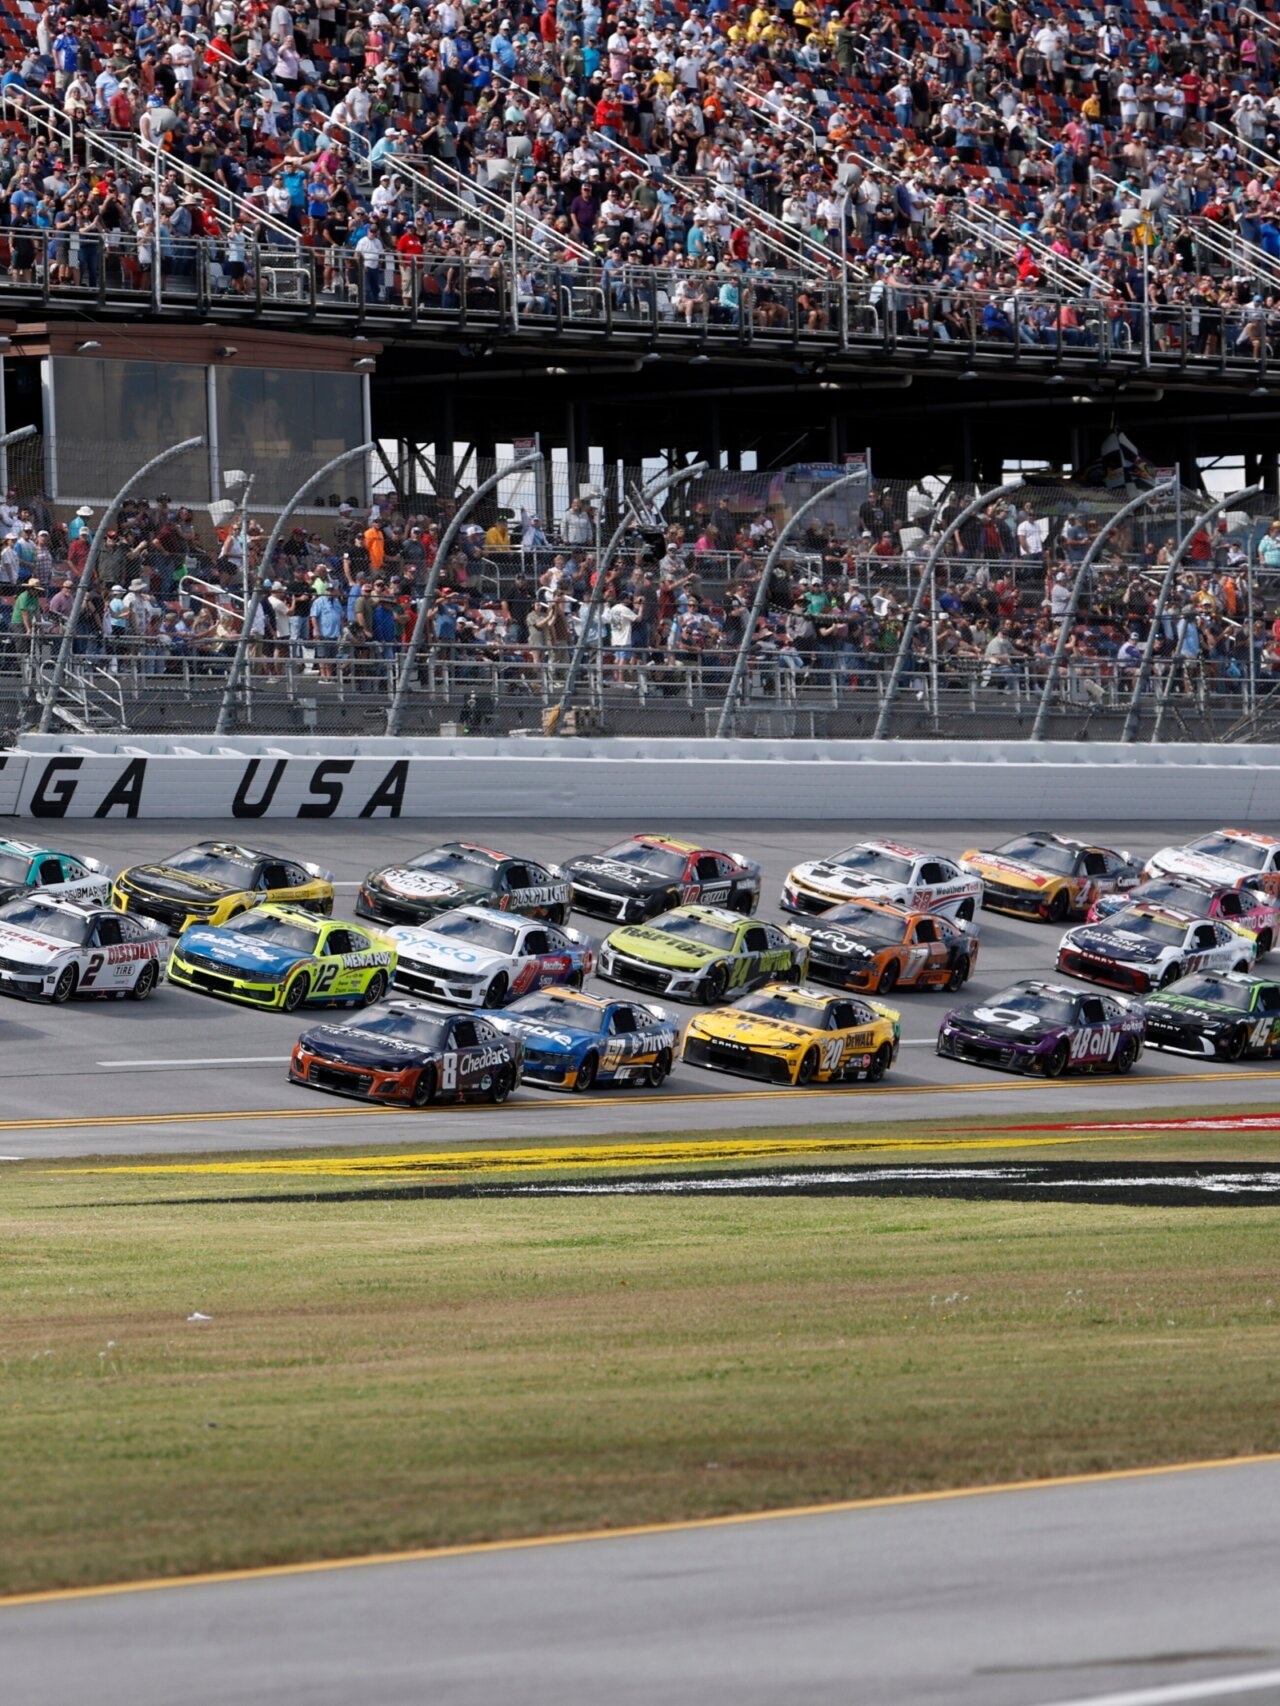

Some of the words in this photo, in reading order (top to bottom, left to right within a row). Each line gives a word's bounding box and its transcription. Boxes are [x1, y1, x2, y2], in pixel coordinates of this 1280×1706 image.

[232, 757, 409, 819] USA
[701, 889, 730, 904] GRIZZLY
[811, 929, 875, 958] Kroger
[1082, 929, 1148, 953] NATIONAL
[80, 953, 104, 987] 2
[116, 966, 133, 976] TIRE
[342, 952, 391, 970] MENARDS
[311, 964, 340, 993] 12
[1147, 1020, 1181, 1032] CAMRY
[711, 1038, 747, 1051] CAMRY
[822, 1038, 844, 1070] 20
[1071, 1028, 1092, 1060] 48
[1089, 1025, 1120, 1062] ally
[442, 1052, 458, 1090] 8
[460, 1044, 510, 1076] Cheddar's
